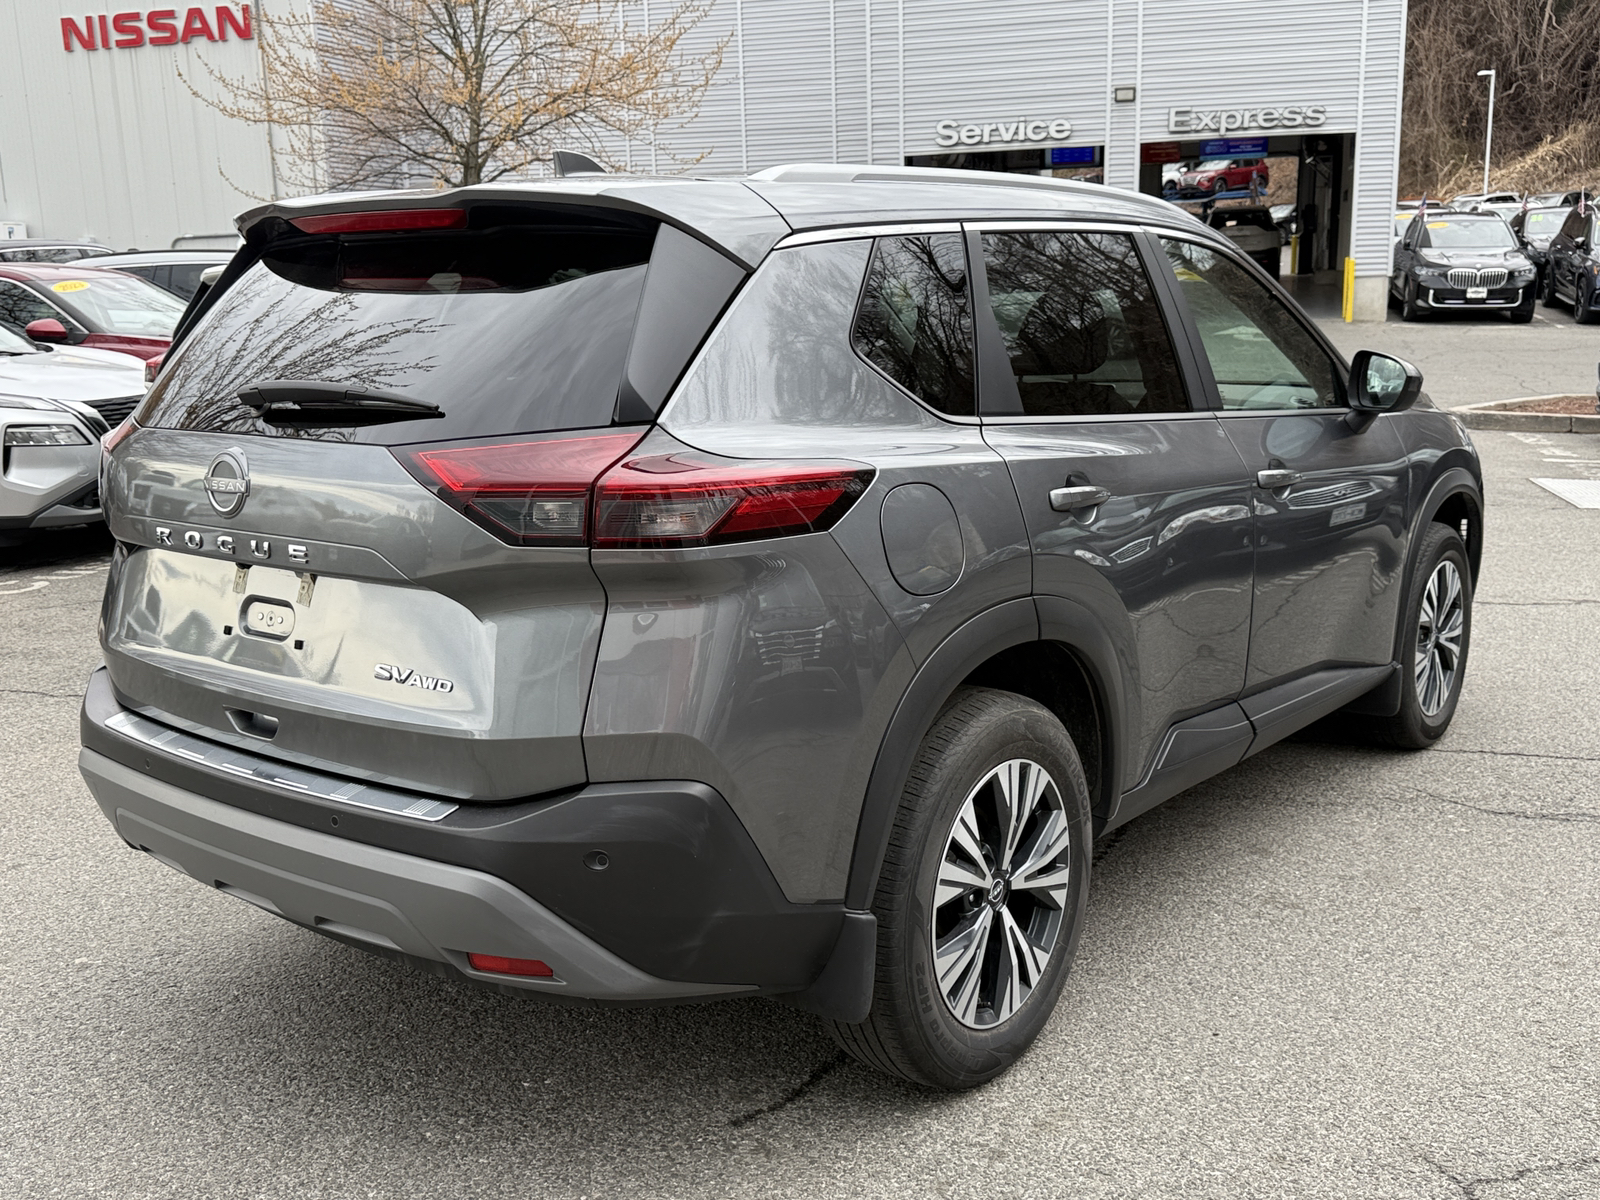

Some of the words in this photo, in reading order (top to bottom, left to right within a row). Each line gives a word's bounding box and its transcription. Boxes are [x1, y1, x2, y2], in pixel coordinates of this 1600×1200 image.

[60, 4, 253, 52] NISSAN
[934, 116, 1073, 147] Service
[1167, 105, 1327, 136] Express
[203, 478, 246, 493] NISSAN
[155, 526, 310, 565] ROGUE
[374, 663, 414, 684] SV
[408, 674, 454, 694] AWD
[915, 961, 933, 1015] HP2
